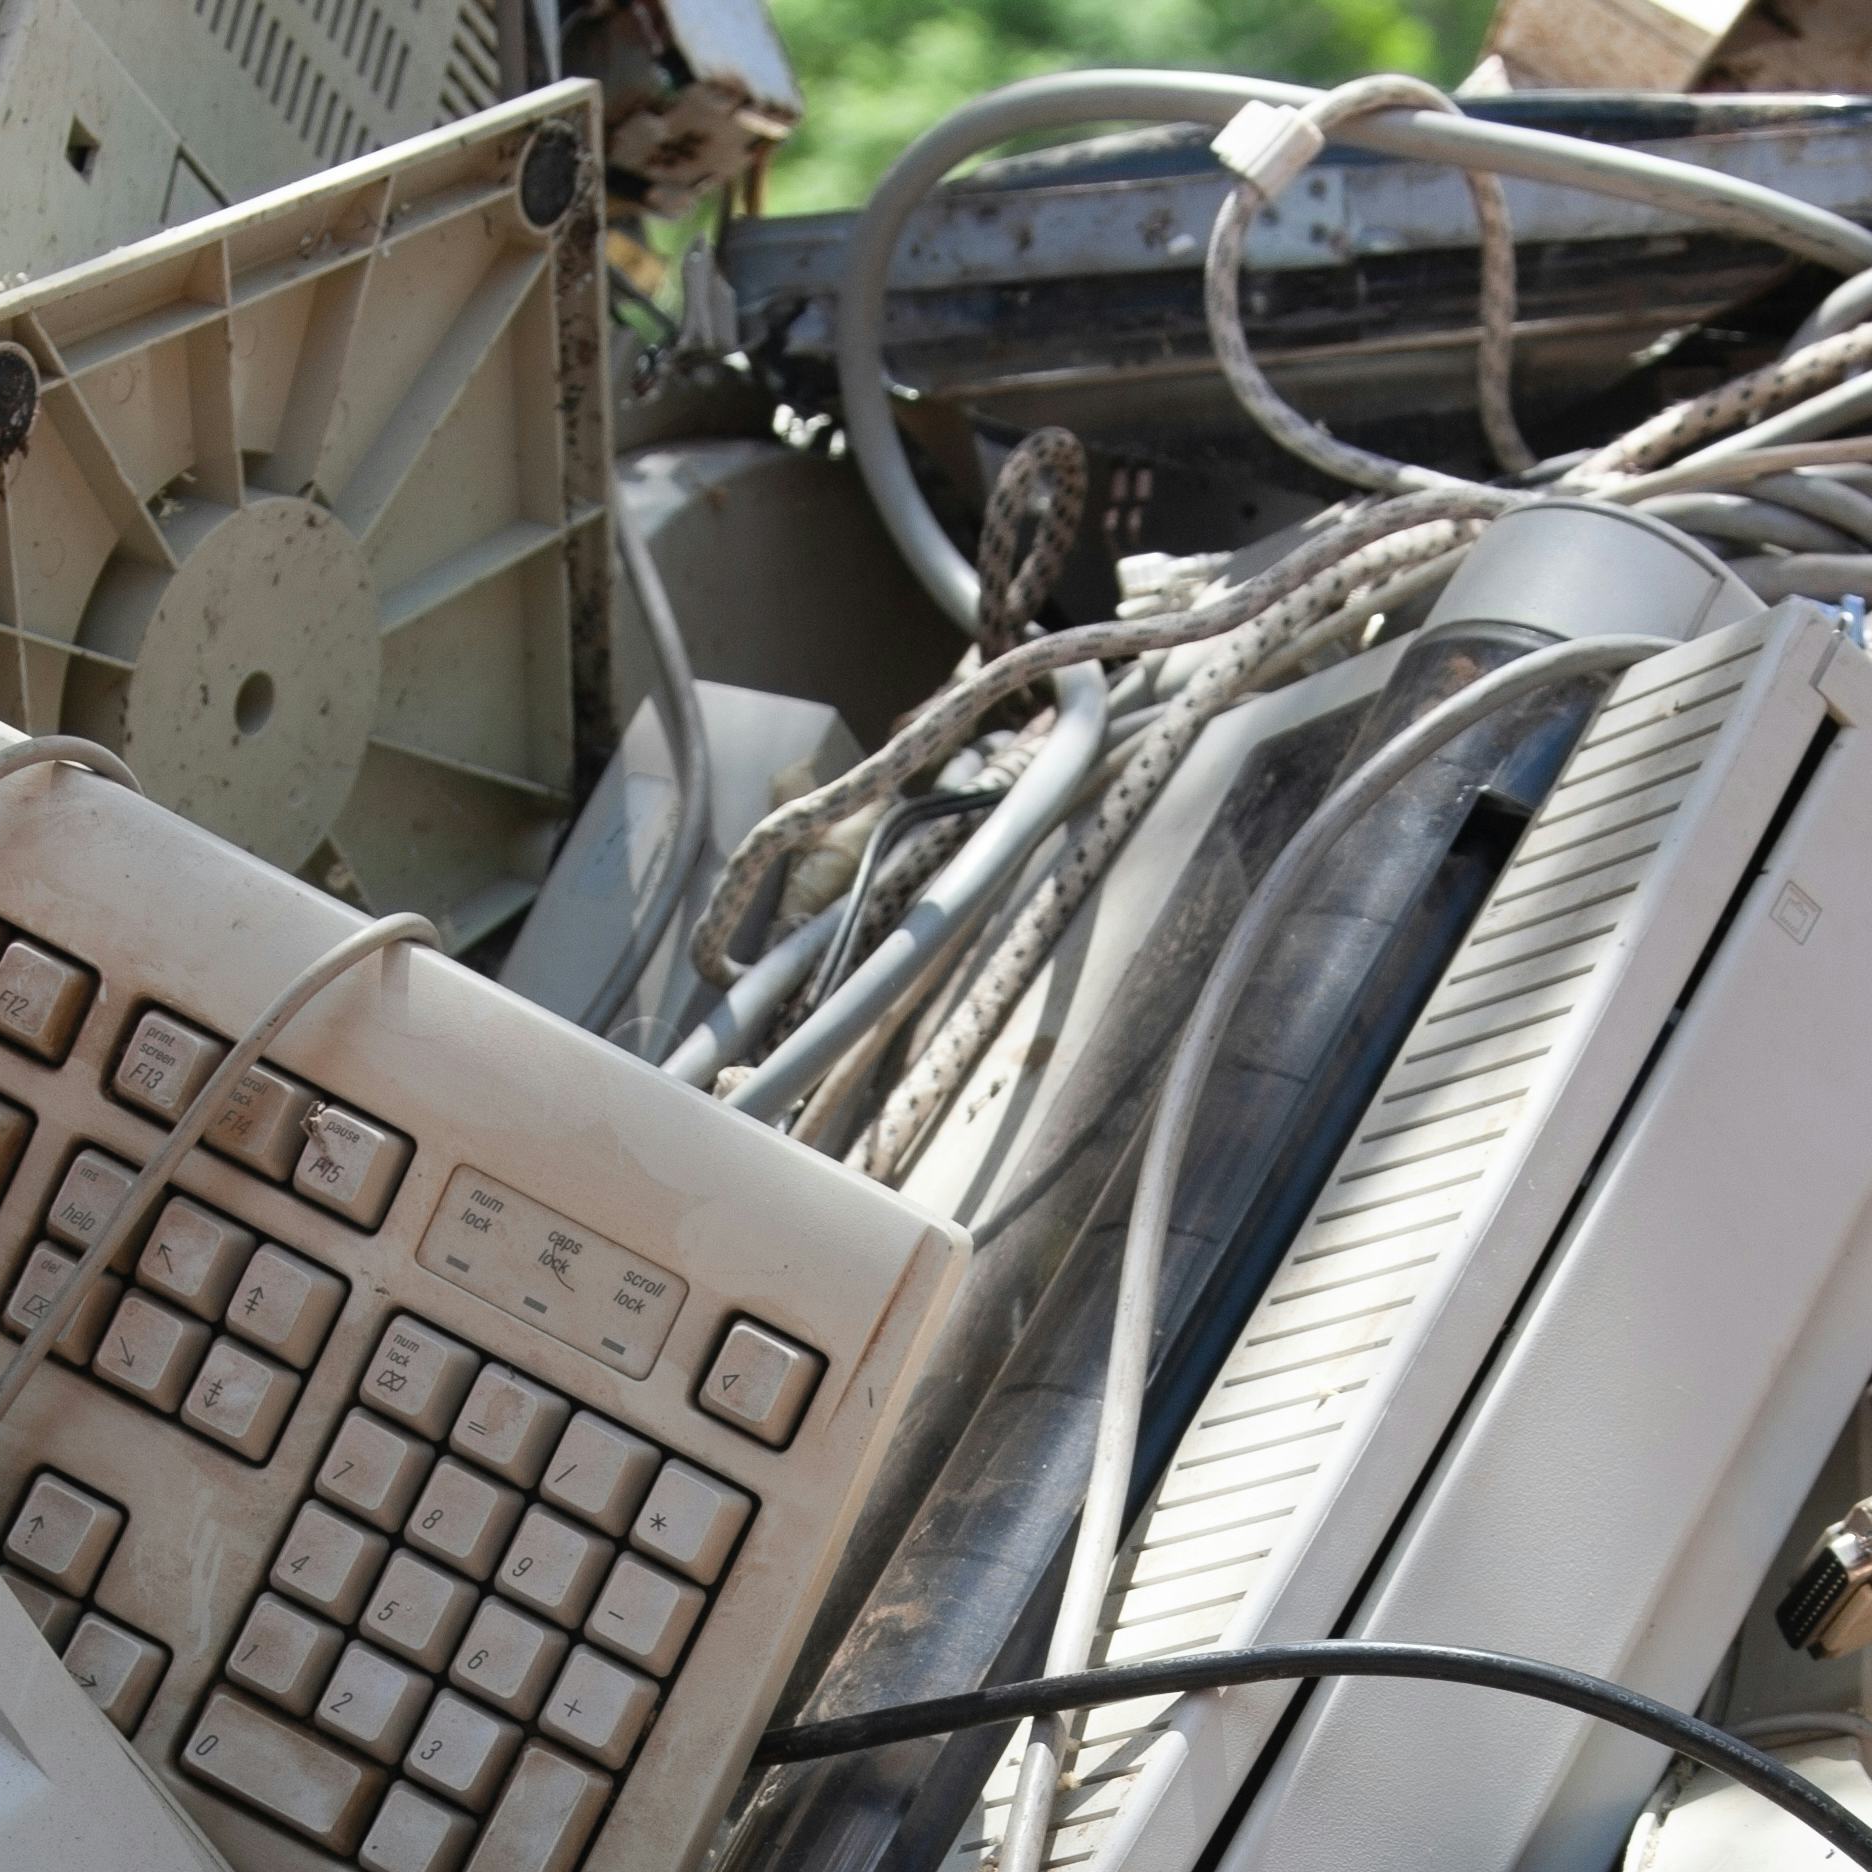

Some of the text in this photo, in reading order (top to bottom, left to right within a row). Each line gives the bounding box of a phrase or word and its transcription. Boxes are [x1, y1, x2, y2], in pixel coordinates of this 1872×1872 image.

[145, 1024, 177, 1047] print
[139, 1041, 177, 1067] screen
[131, 1061, 165, 1089] F13
[219, 1108, 252, 1135] F14
[326, 1119, 360, 1144] pause
[470, 1187, 505, 1213] num
[59, 1204, 96, 1231] help
[460, 1208, 493, 1234] lock
[546, 1227, 583, 1257] caps
[537, 1249, 572, 1275] lock
[621, 1268, 667, 1300] scroll
[613, 1289, 646, 1316] lock
[391, 1331, 421, 1354] num
[386, 1347, 410, 1368] lock
[333, 1461, 354, 1481] 7
[422, 1508, 444, 1529] 8
[289, 1554, 311, 1575] 4
[512, 1556, 534, 1578] 9
[378, 1600, 400, 1622] 5
[240, 1644, 259, 1664] 1
[467, 1648, 489, 1670] 6
[330, 1692, 355, 1713] 2
[420, 1739, 442, 1761] 3
